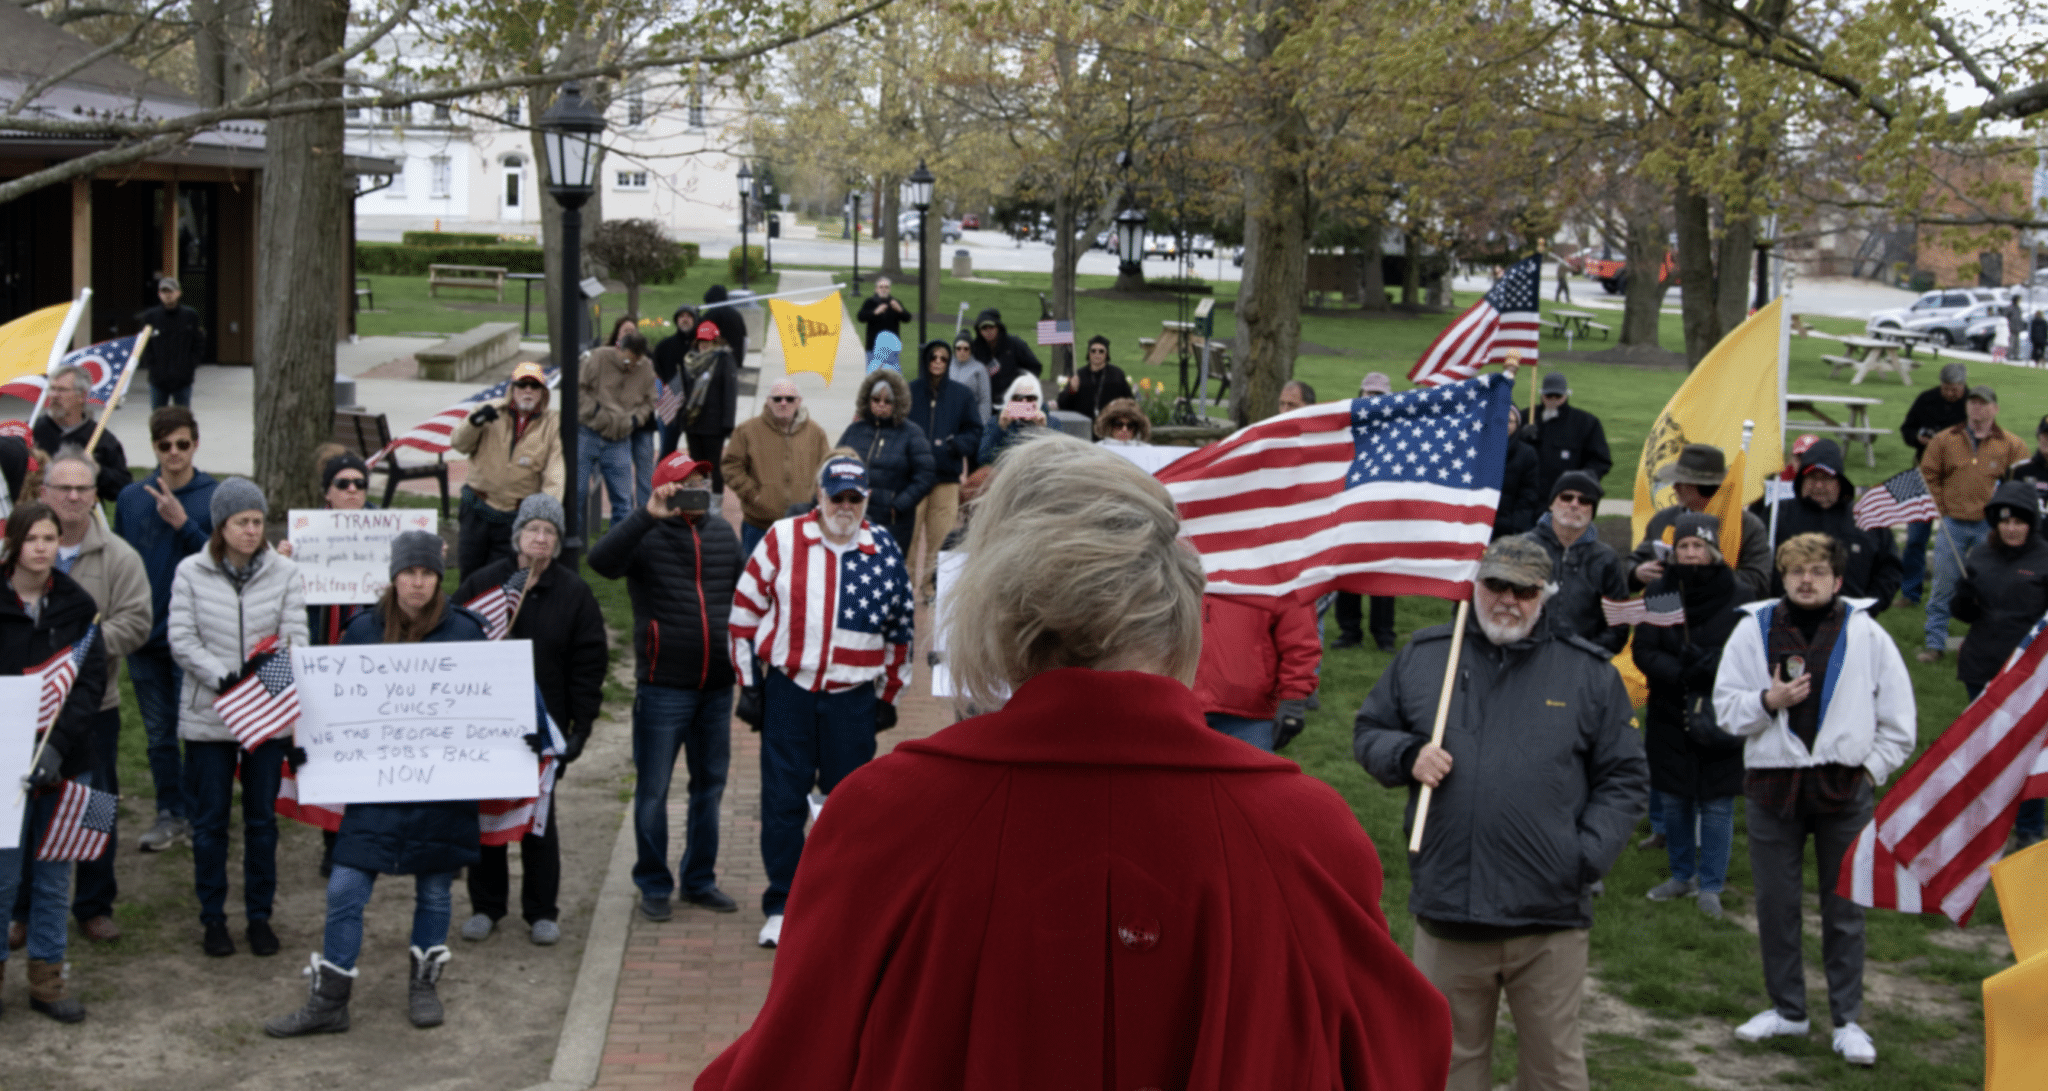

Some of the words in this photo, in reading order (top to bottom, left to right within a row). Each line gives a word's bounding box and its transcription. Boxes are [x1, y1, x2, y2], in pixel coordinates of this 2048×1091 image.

[331, 513, 402, 531] TYRANNY
[301, 655, 347, 676] HEY
[359, 654, 458, 675] DeWINE
[333, 682, 368, 697] DID
[385, 682, 416, 699] YOU
[430, 681, 493, 697] FLUNK
[310, 730, 335, 745] WE
[342, 727, 370, 740] THE
[381, 724, 454, 741] PEOPLE
[333, 749, 368, 763] OUR
[377, 745, 430, 760] JOBS
[443, 745, 491, 763] BACK
[377, 764, 435, 787] NOW
